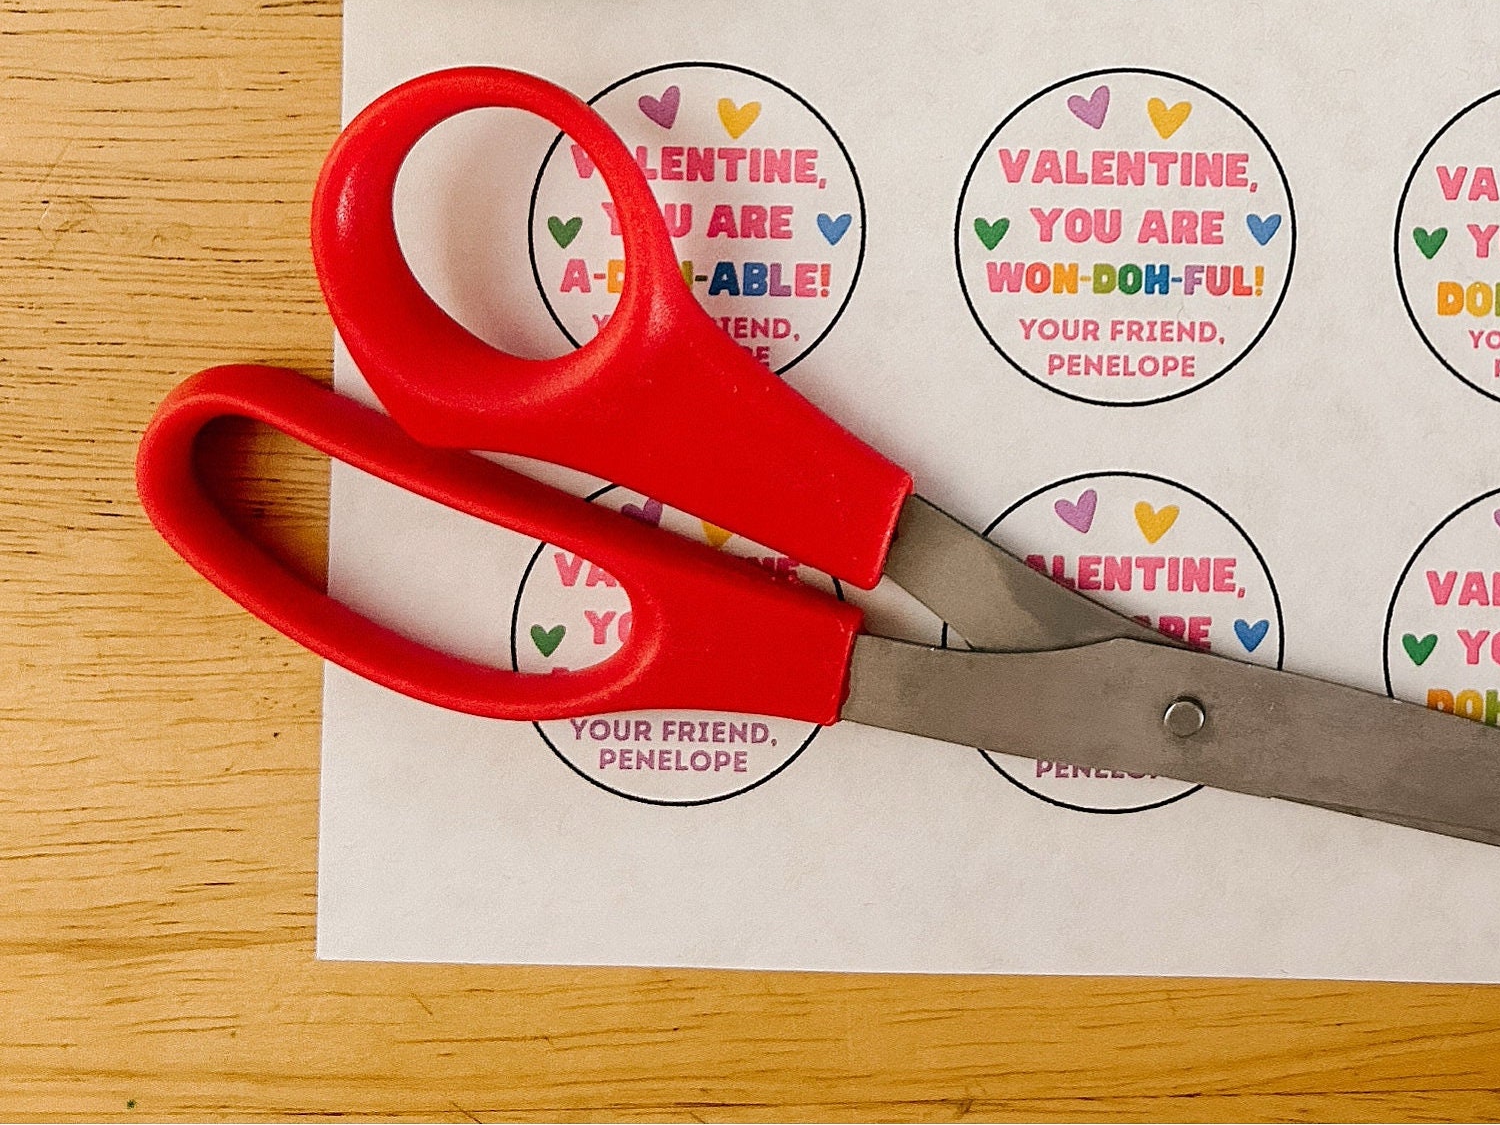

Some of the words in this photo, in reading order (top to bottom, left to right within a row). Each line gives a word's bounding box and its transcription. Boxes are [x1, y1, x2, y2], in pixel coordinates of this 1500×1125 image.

[571, 145, 826, 189] VLENTINE,
[998, 149, 1258, 193] VALENTINE,
[602, 203, 692, 238] YU
[706, 204, 793, 239] ARE
[1030, 208, 1122, 244] YOU
[1137, 210, 1225, 245] ARE
[986, 262, 1264, 297] WON-DOH-FUL!
[1019, 319, 1100, 341] YOUR
[1110, 320, 1225, 345] FRIEND,
[1048, 354, 1195, 378] PENELOPE
[570, 719, 652, 744] YOUR
[662, 721, 778, 747] FRIEND,
[600, 748, 748, 773] PENELOPE
